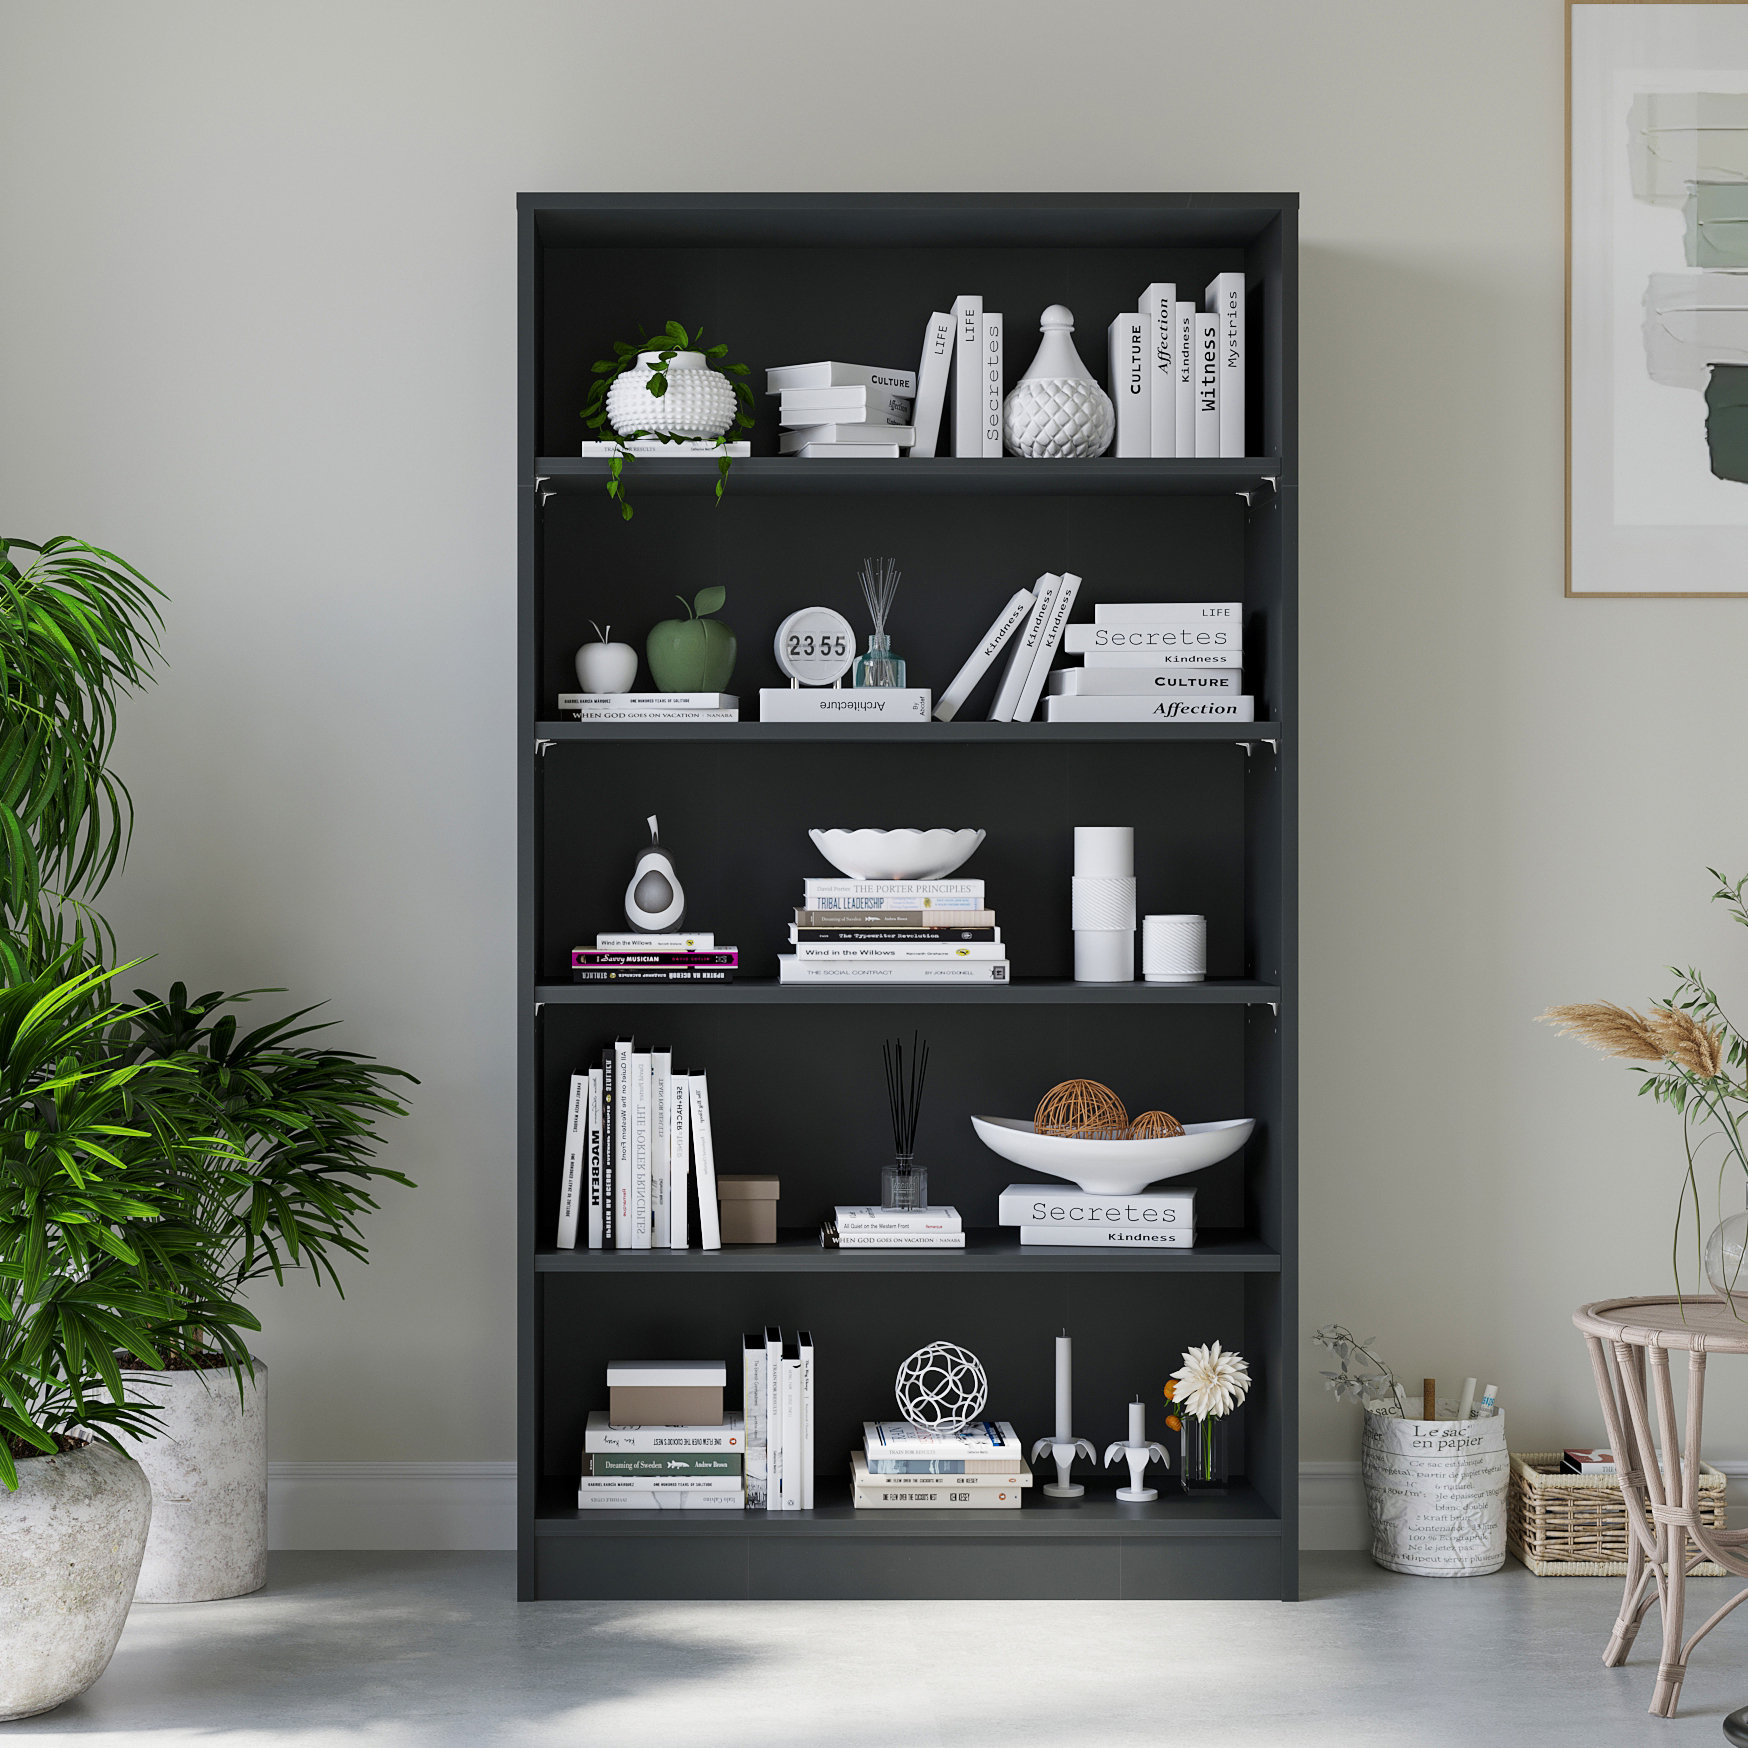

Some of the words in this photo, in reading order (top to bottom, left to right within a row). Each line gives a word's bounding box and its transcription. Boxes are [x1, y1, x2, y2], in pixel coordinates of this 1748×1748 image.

[965, 308, 975, 342] LIFE
[1227, 290, 1240, 368] Mystries
[934, 325, 948, 355] LIFE
[1156, 297, 1172, 375] Affection
[1181, 316, 1190, 383] Kindness
[1130, 324, 1142, 395] CULTURE
[1200, 327, 1216, 412] Witness
[871, 374, 910, 388] CULTURE
[987, 325, 999, 441] Secretes
[1027, 589, 1053, 648] Kindness
[1046, 589, 1072, 648] Kindness
[1202, 608, 1230, 617] LIFE
[984, 604, 1024, 656] Kindness
[1095, 628, 1228, 646] Secretes
[1164, 655, 1227, 663] Kindness
[1154, 677, 1229, 687] CULTURE
[820, 701, 886, 711] Architecture
[1153, 702, 1238, 717] Affection
[855, 885, 874, 893] THE
[876, 885, 914, 893] PORTER
[916, 885, 971, 893] PRINCIPLES
[817, 897, 842, 910] TRIBAL
[843, 897, 885, 910] LEADERSHIP
[600, 954, 626, 965] Savvy
[1032, 1202, 1176, 1223] Secretes
[1108, 1233, 1176, 1242] Kindness
[1376, 1406, 1397, 1416] sac
[1413, 1425, 1439, 1437] Le
[1441, 1428, 1467, 1438] sac
[653, 1438, 664, 1446] NEST
[664, 1438, 683, 1446] CUCKOO'S
[691, 1438, 702, 1446] OVER
[703, 1438, 714, 1446] FLEW
[714, 1438, 722, 1446] ONE
[1413, 1440, 1433, 1449] en
[1438, 1436, 1484, 1451] papier
[605, 1461, 633, 1470] Dreaming
[633, 1461, 640, 1469] of
[639, 1461, 663, 1469] Sweden
[1416, 1472, 1445, 1482] partir
[1462, 1502, 1489, 1511] doublé
